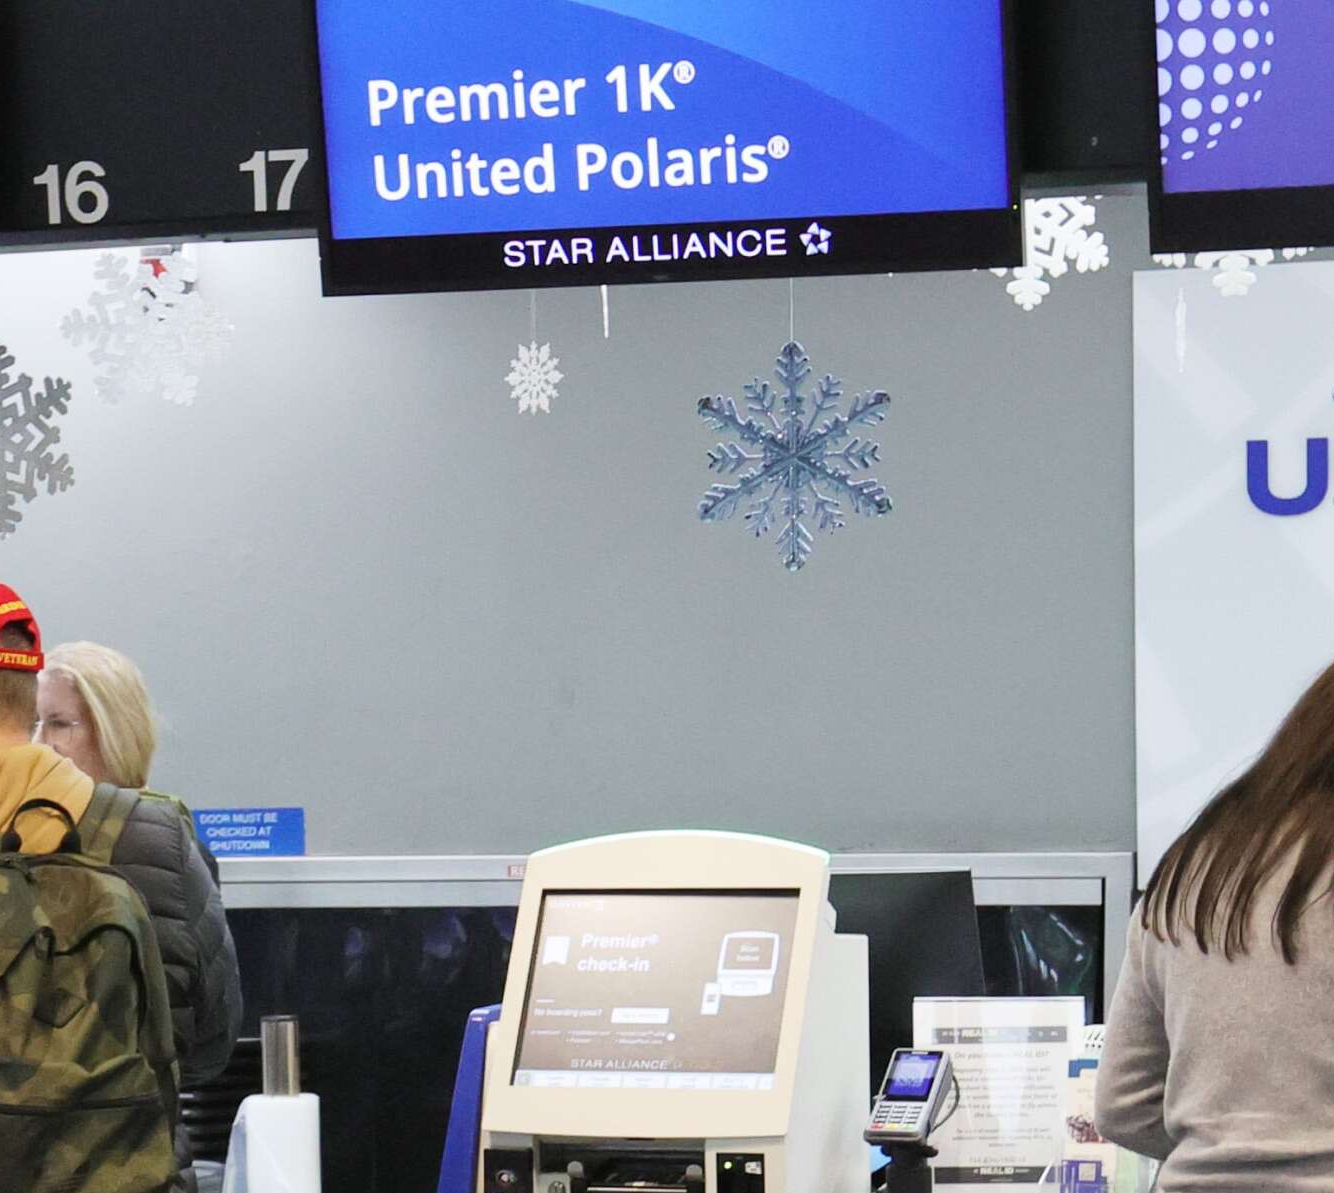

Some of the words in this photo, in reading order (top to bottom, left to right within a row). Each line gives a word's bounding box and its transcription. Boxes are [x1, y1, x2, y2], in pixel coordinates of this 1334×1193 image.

[367, 70, 587, 127] Premier
[33, 161, 109, 224] 16
[239, 148, 309, 212] 17
[374, 142, 557, 201] United
[503, 237, 593, 268] STAR
[605, 228, 787, 262] ALLIANCE
[232, 812, 261, 824] MUST
[258, 826, 273, 836] AT
[577, 956, 651, 972] check-in
